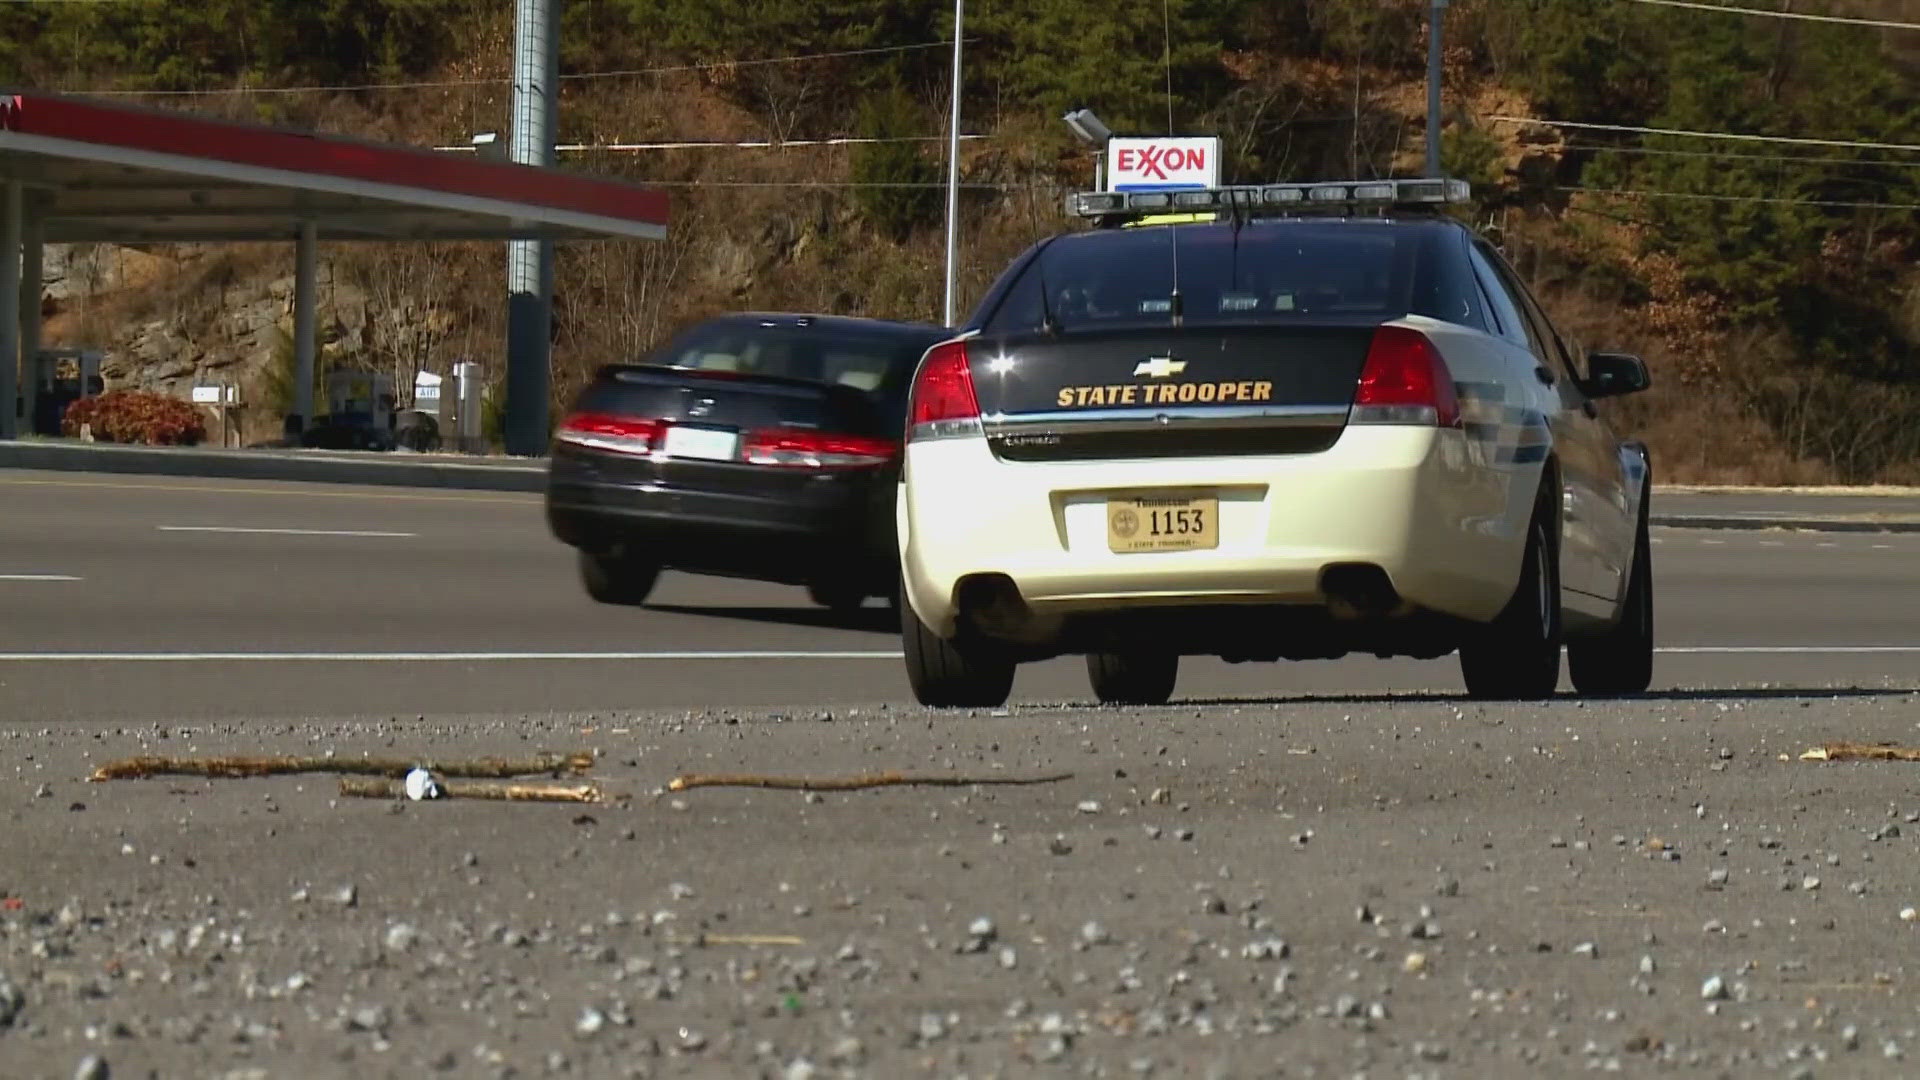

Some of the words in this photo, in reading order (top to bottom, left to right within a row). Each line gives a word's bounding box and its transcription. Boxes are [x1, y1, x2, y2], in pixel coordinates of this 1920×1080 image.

[1118, 145, 1205, 180] EXXON
[1057, 385, 1138, 407] STATE
[1142, 380, 1273, 402] TROOPER
[1150, 509, 1204, 536] 1153
